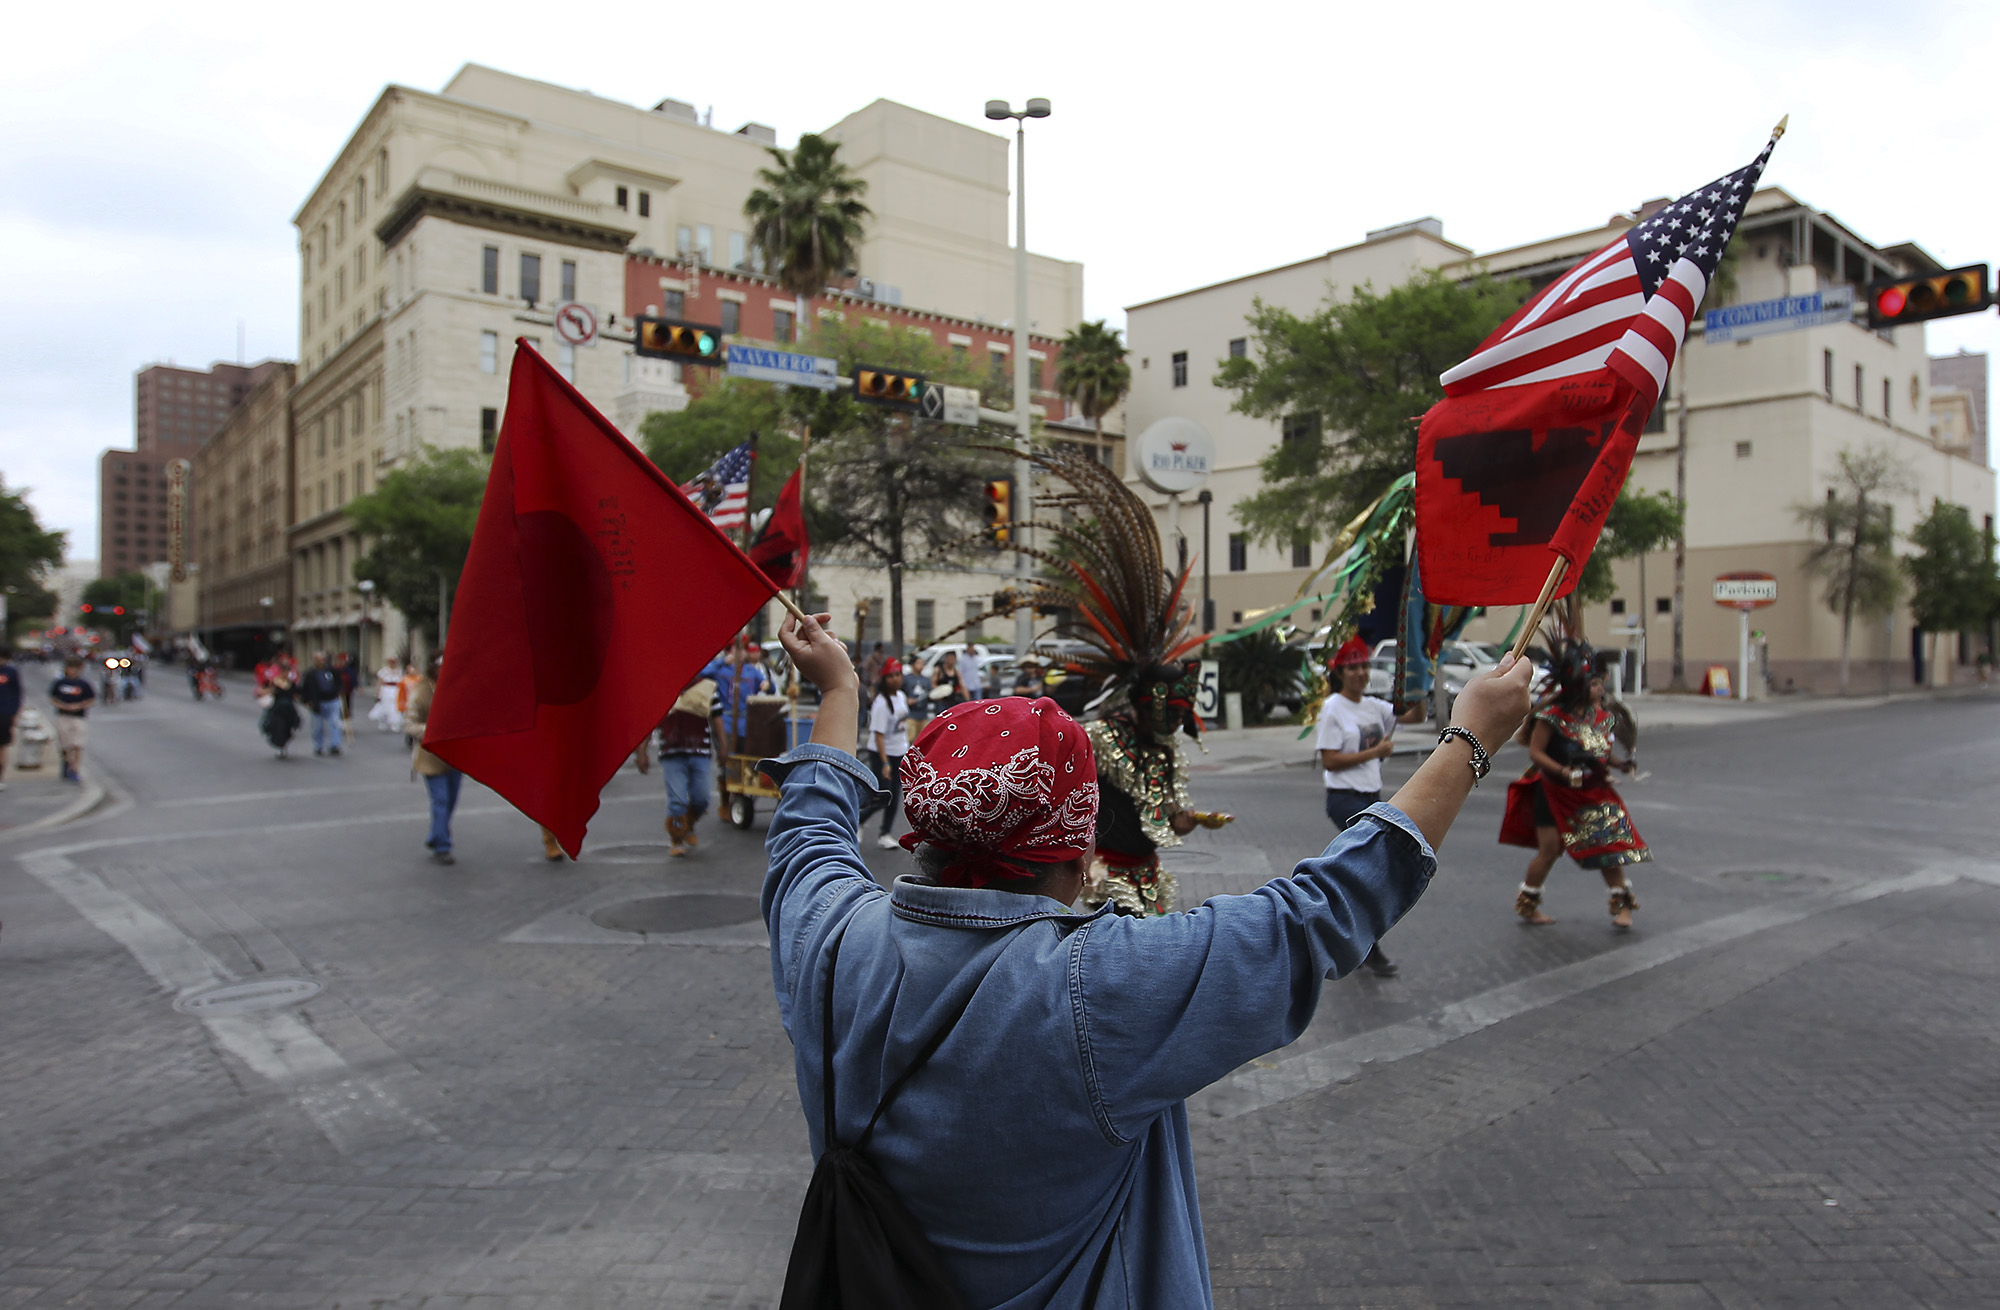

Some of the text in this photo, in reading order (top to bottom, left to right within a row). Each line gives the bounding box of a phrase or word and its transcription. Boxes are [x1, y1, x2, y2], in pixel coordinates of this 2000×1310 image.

[1719, 296, 1820, 326] COMMERCE
[729, 346, 814, 373] NAVARRO
[1716, 581, 1775, 598] Parking
[1202, 671, 1217, 712] 5
